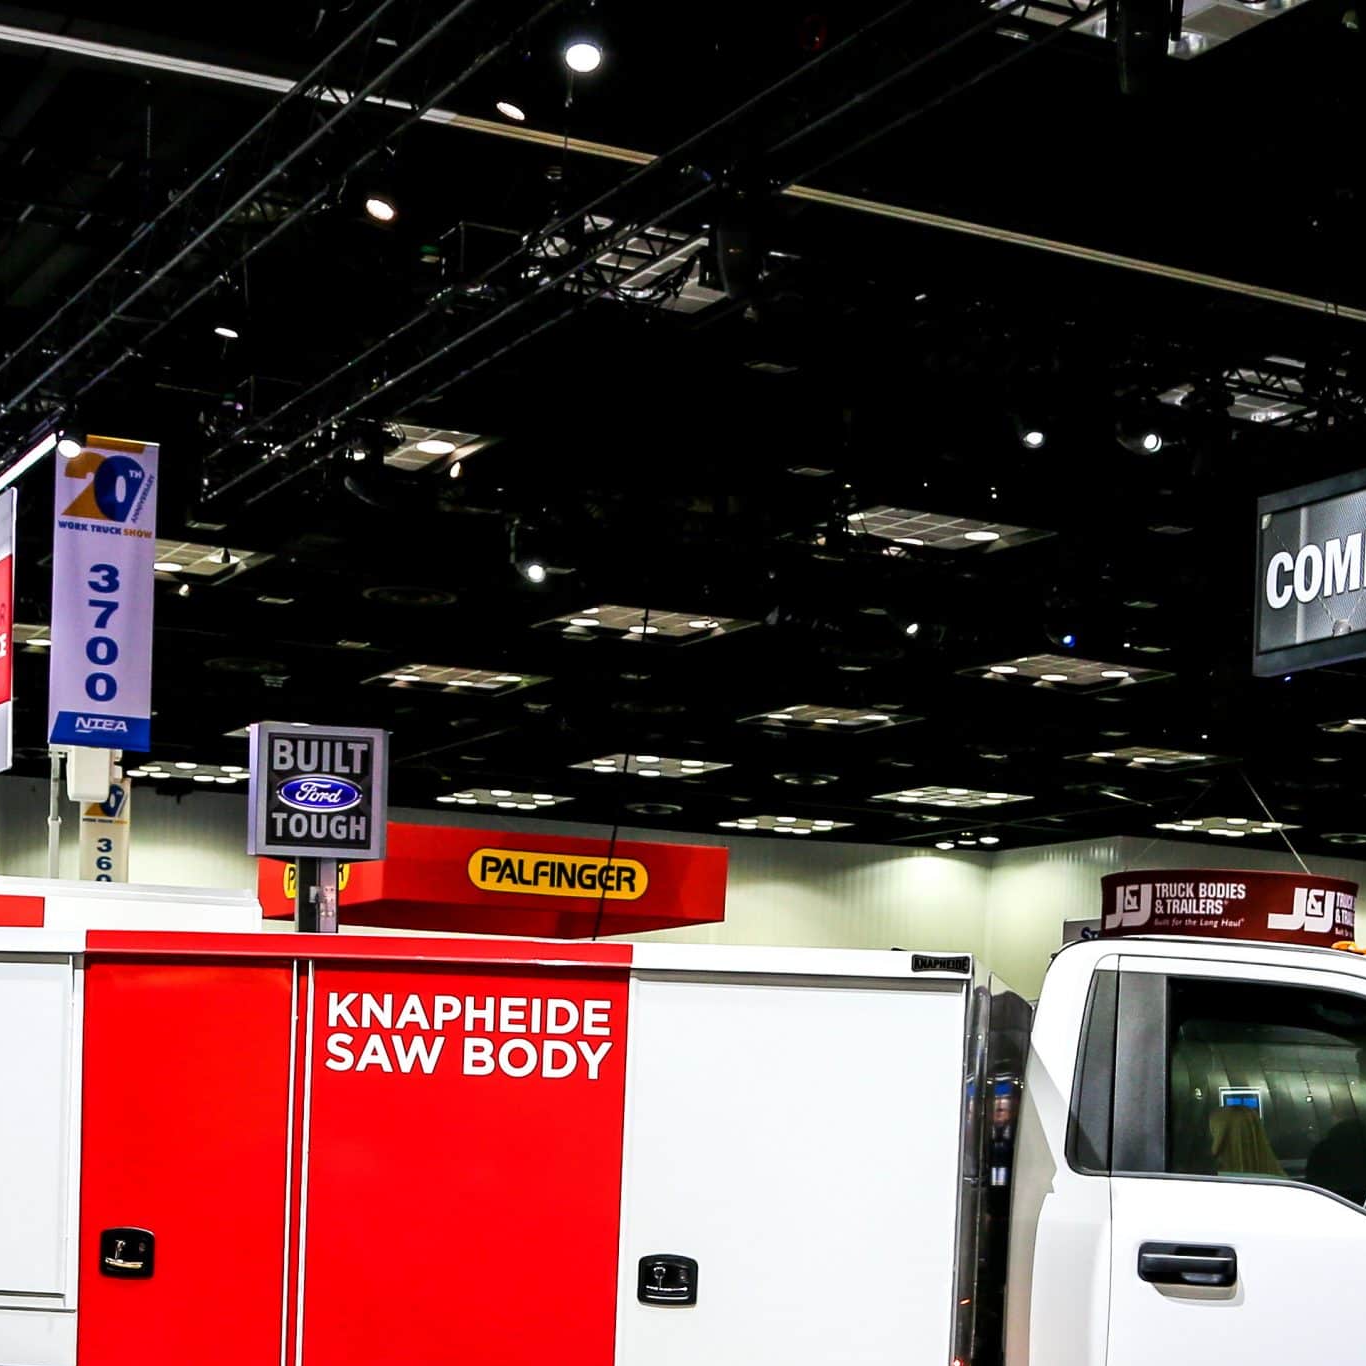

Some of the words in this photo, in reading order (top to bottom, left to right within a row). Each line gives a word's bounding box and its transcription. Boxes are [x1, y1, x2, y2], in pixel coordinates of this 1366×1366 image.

[58, 521, 89, 532] WORK
[91, 525, 122, 535] TRUCK
[123, 528, 153, 538] SHOW
[85, 563, 120, 702] 3700
[273, 739, 369, 774] BUILT
[295, 781, 342, 803] Ford
[272, 812, 366, 841] TOUGH
[480, 855, 637, 893] PALFINGER
[1155, 882, 1195, 899] TRUCK
[1198, 882, 1247, 900] BODIES
[1155, 899, 1165, 915] &
[1166, 899, 1224, 915] TRAILERS
[1200, 918, 1219, 929] Long
[327, 992, 612, 1036] KNAPHEIDE
[325, 1033, 446, 1074] SAW
[463, 1037, 613, 1080] BODY
